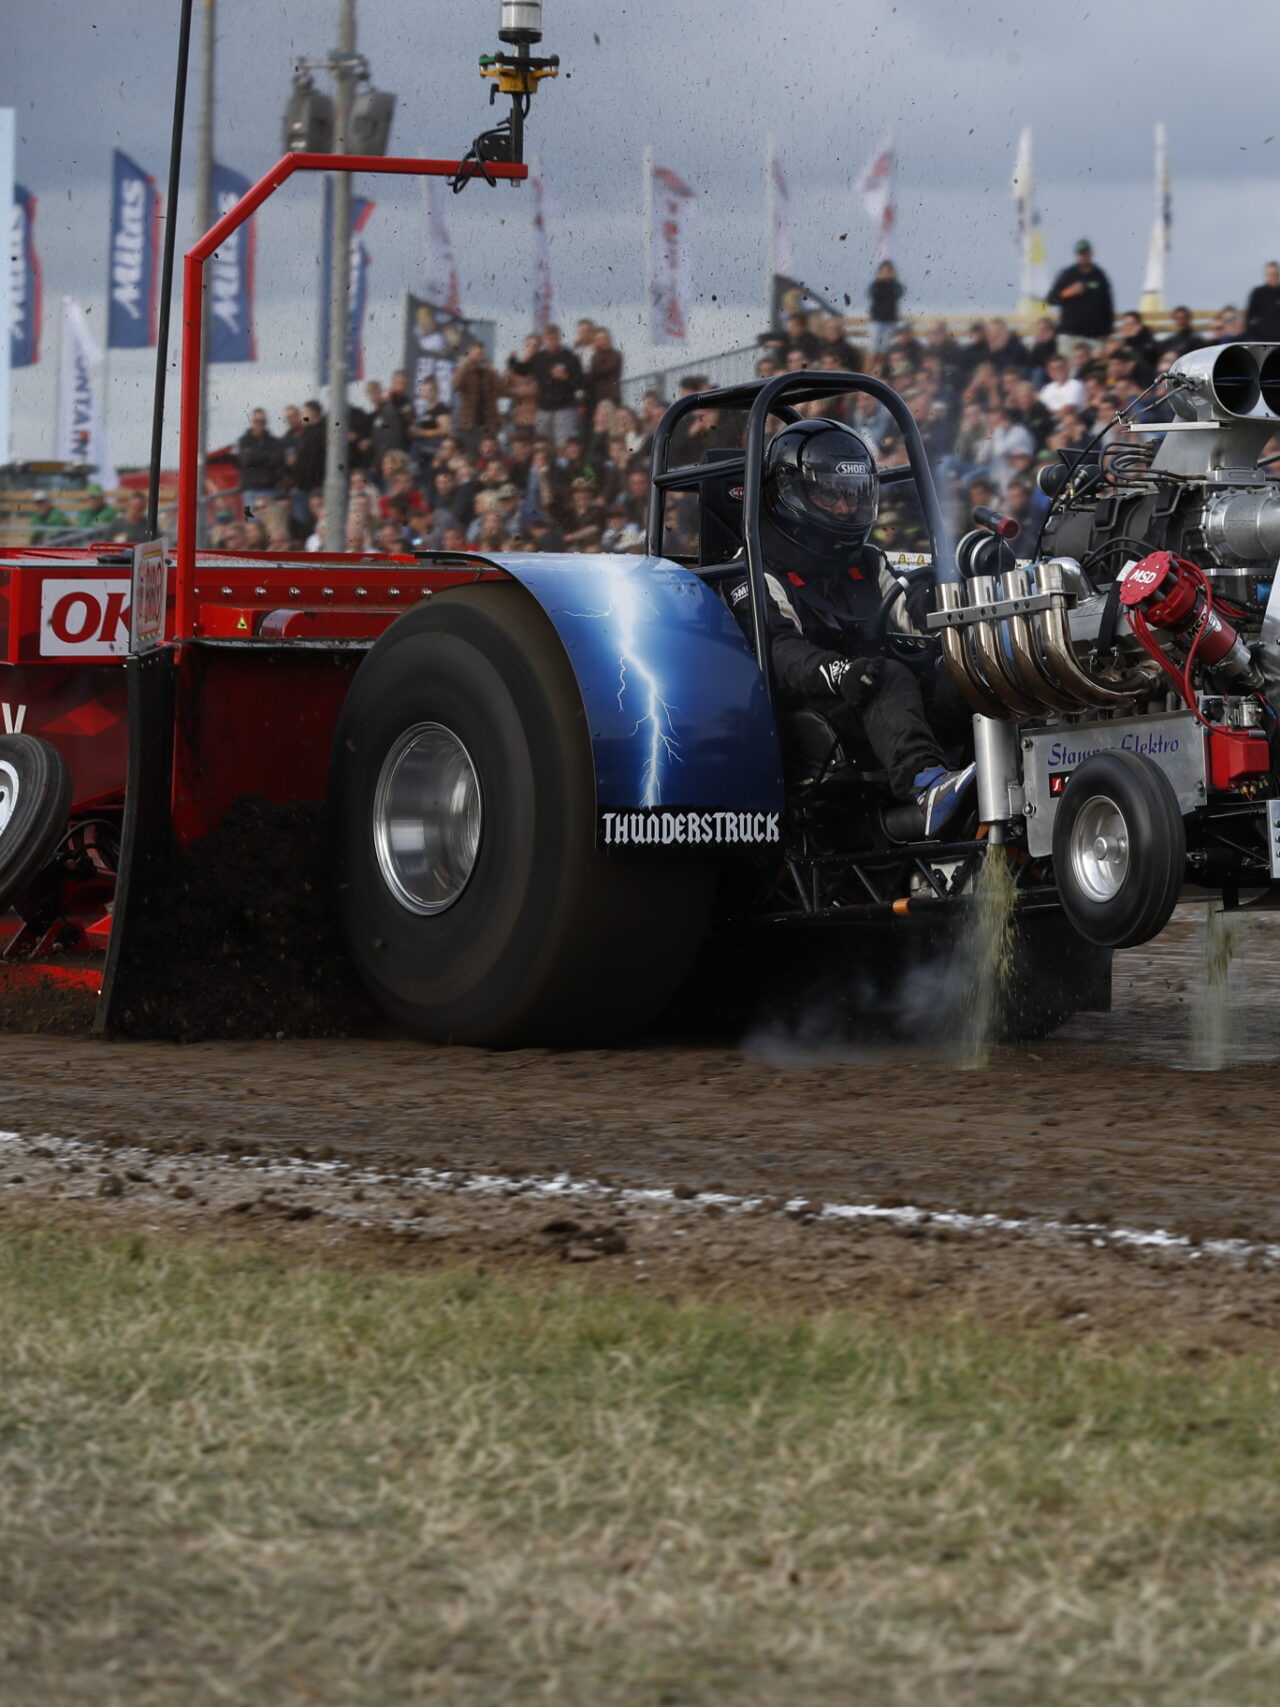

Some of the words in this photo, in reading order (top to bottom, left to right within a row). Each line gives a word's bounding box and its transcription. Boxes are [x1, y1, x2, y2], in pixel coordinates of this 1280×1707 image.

[113, 179, 147, 319] Mitas
[211, 191, 241, 334] Mits
[1129, 569, 1157, 584] MSD
[601, 811, 780, 844] THUNDERSTRUCK
